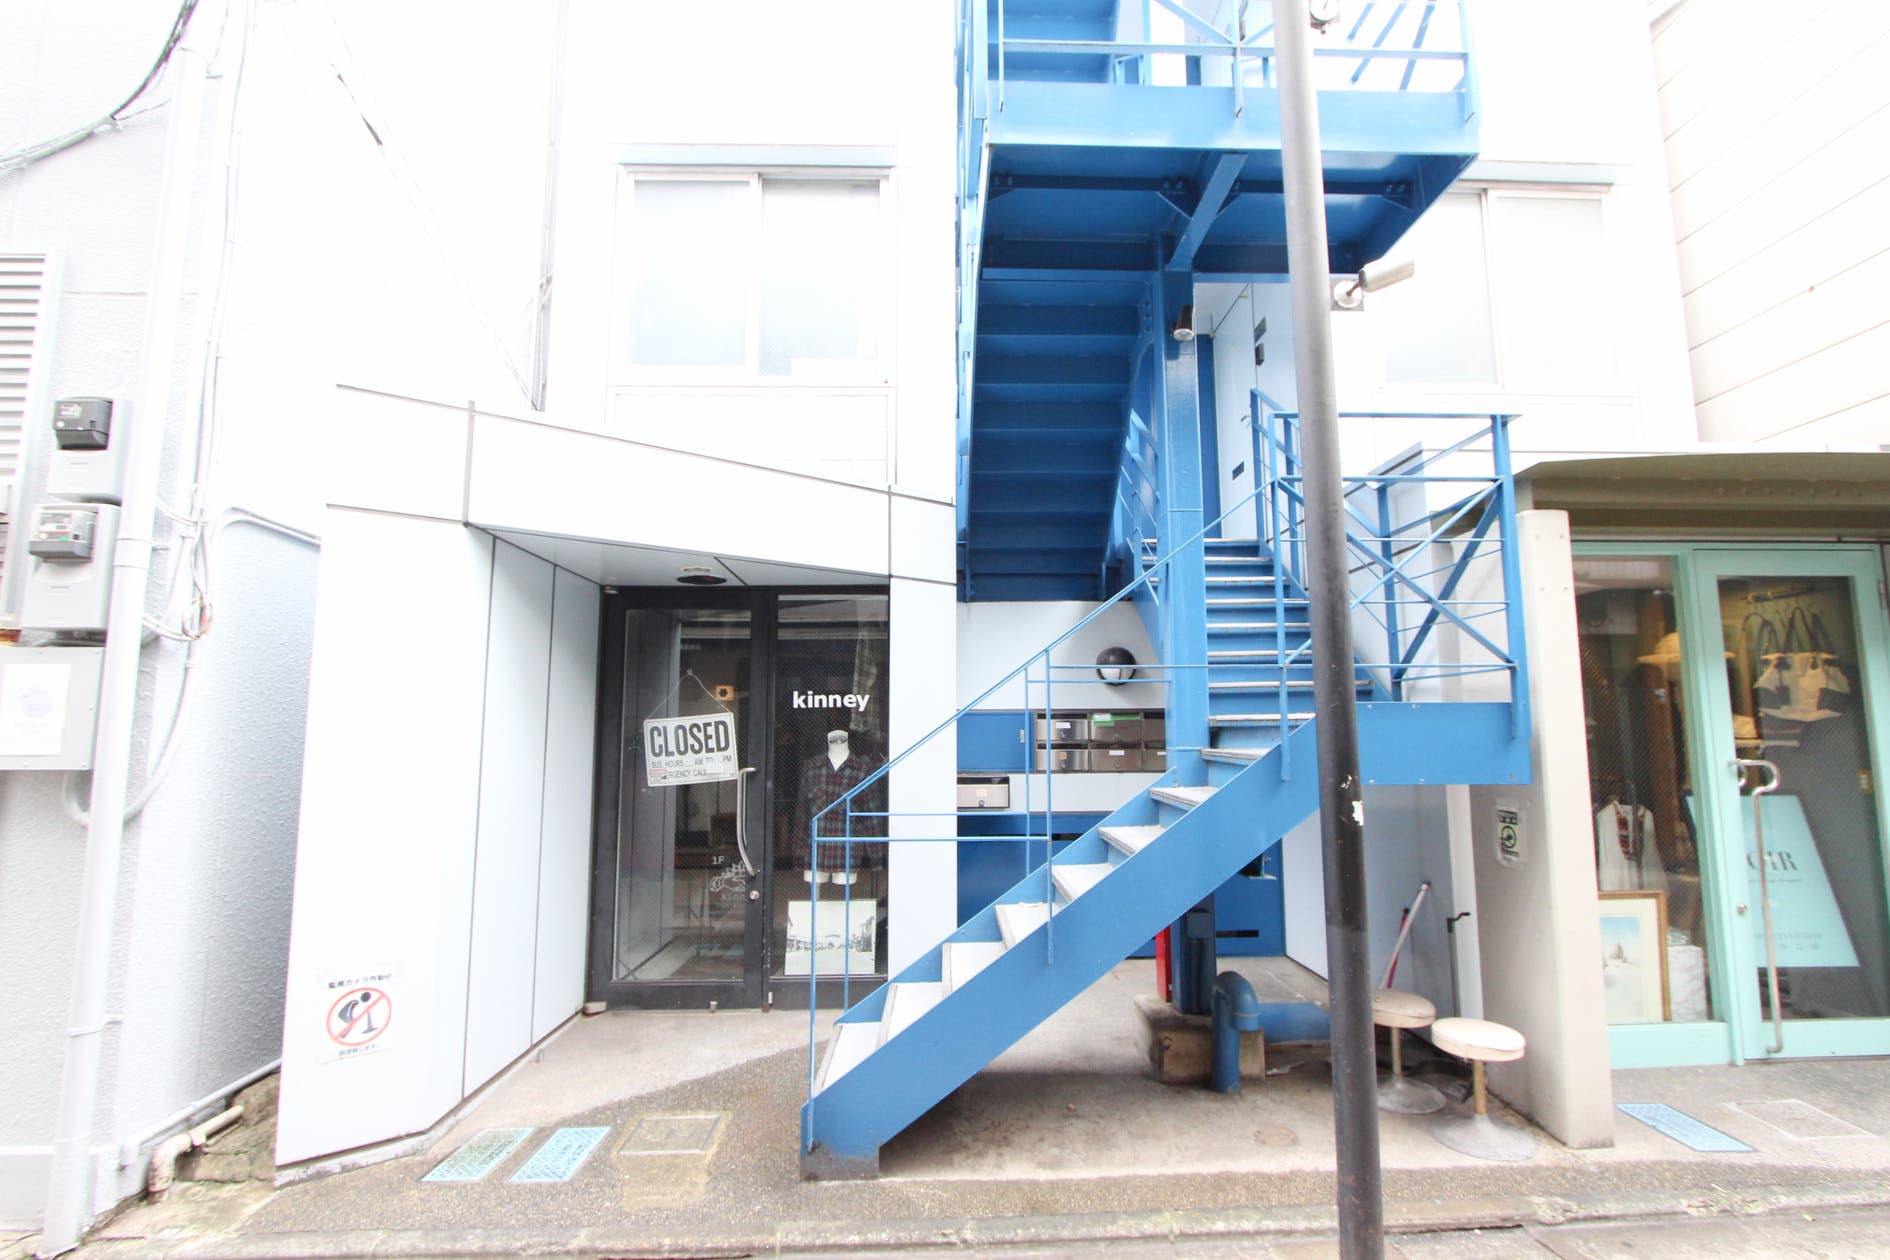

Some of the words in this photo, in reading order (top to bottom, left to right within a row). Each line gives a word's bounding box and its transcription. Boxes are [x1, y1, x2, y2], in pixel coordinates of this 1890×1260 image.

[792, 690, 870, 712] kinney
[650, 720, 729, 757] CLOSED
[665, 760, 684, 768] HOURS
[711, 855, 726, 865] 1F
